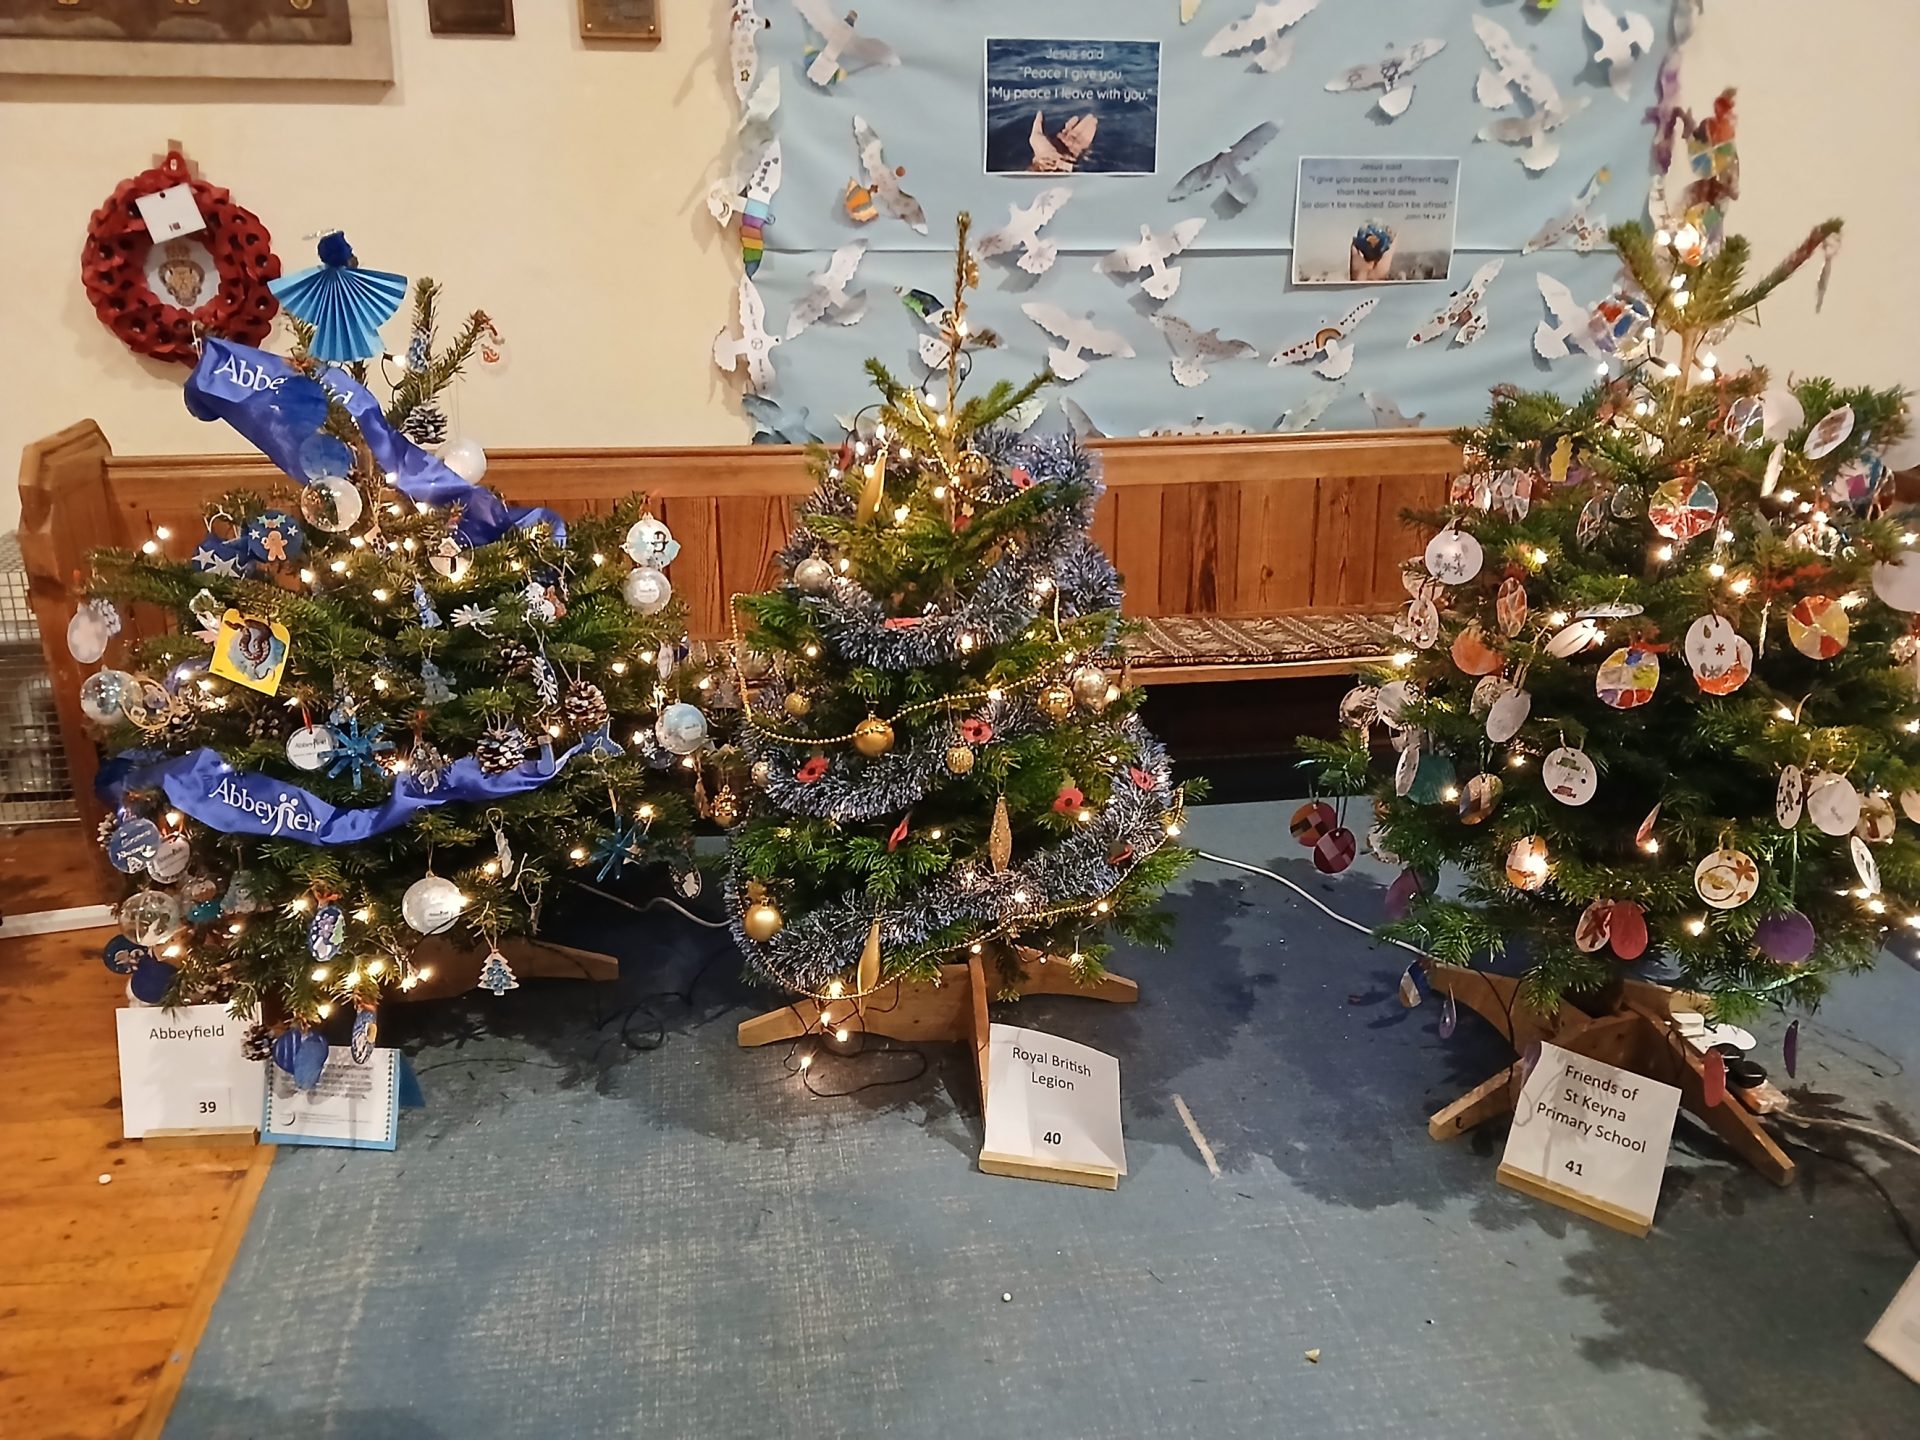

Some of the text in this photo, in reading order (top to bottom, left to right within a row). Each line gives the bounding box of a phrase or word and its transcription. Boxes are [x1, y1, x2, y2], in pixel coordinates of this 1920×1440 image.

[1045, 46, 1104, 60] Jesus said
[1071, 66, 1097, 82] give
[992, 85, 1011, 102] My
[1013, 87, 1051, 102] peace
[1061, 86, 1094, 100] leave
[1096, 87, 1121, 100] with
[1316, 175, 1334, 185] give
[1336, 176, 1352, 185] you
[1353, 175, 1378, 185] peace
[1397, 174, 1431, 184] different
[1433, 176, 1449, 185] way
[1356, 186, 1370, 196] the
[1373, 187, 1396, 196] world
[148, 1023, 226, 1042] Abbeyfield
[1011, 1046, 1092, 1078] Royal British
[1031, 1071, 1075, 1092] Legion
[1564, 1064, 1640, 1102] Friends of
[198, 1100, 218, 1114] 39
[1563, 1088, 1627, 1123] St Keyna
[1536, 1101, 1648, 1154] Primary School
[1043, 1131, 1062, 1146] 40
[1564, 1160, 1584, 1177] 41
